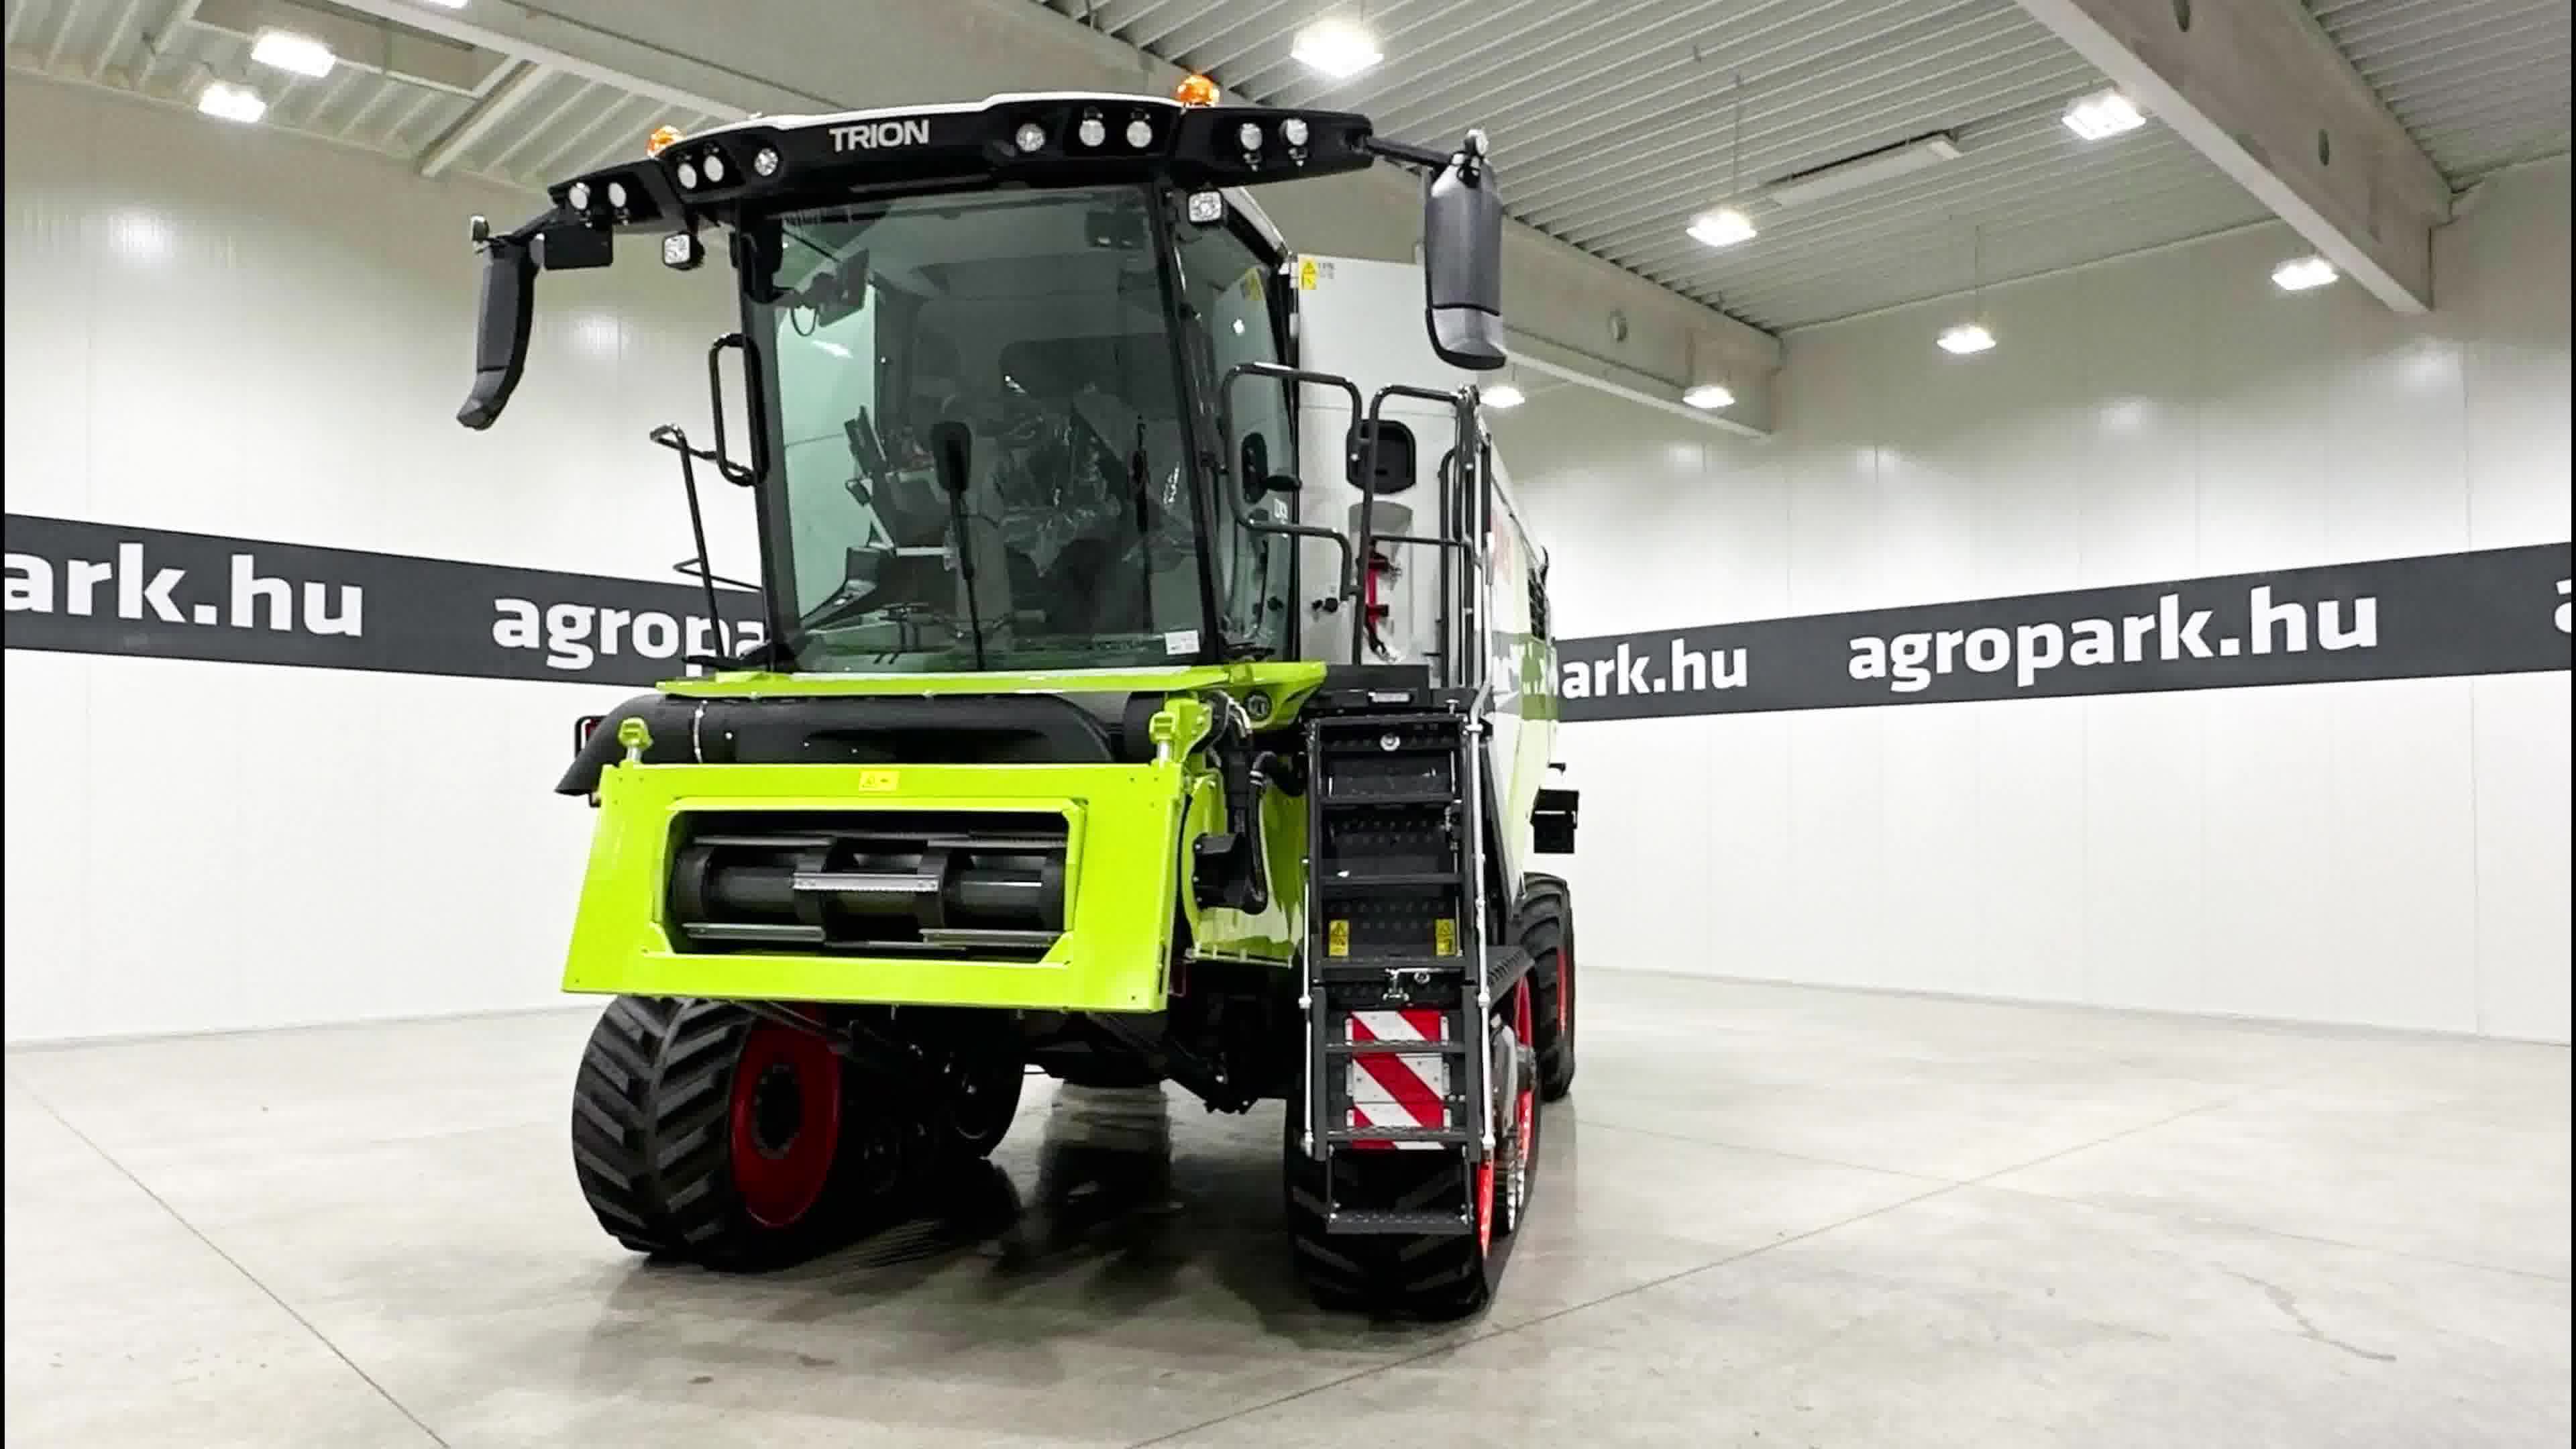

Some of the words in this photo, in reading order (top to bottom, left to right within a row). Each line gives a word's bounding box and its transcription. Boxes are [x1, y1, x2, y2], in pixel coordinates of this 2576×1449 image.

[829, 119, 930, 152] TRION
[5, 542, 363, 637] ark.hu
[1849, 586, 2377, 692] agropark.hu
